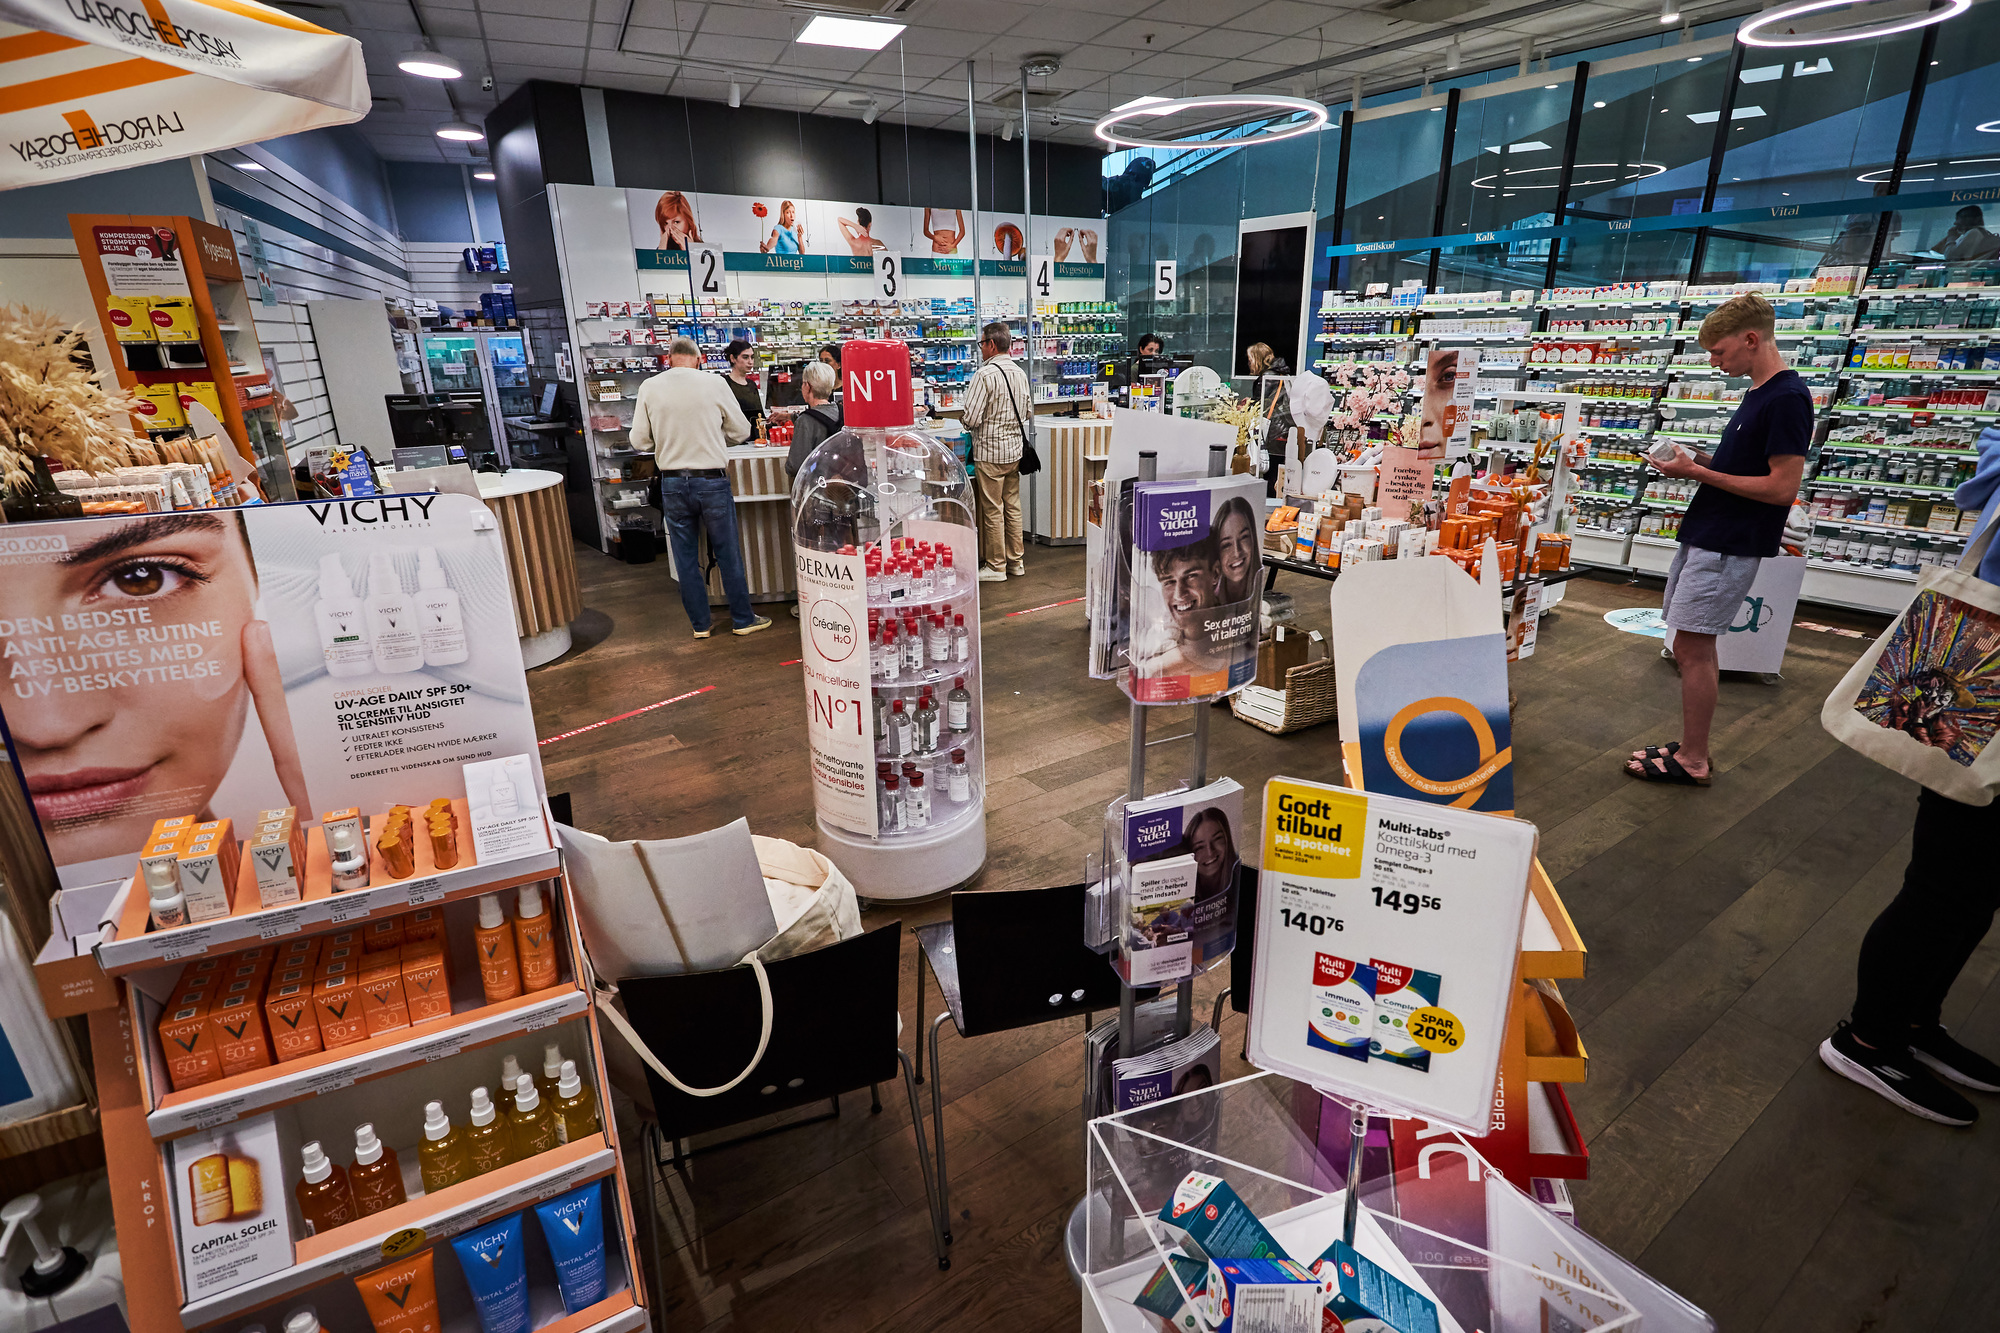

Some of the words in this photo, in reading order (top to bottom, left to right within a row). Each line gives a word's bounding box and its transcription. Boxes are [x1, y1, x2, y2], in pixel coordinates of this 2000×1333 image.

[1770, 205, 1800, 217] Vital
[1608, 220, 1632, 231] Vital
[1475, 232, 1495, 242] Kalk
[201, 236, 233, 266] Rygestop
[1355, 240, 1396, 253] Kosttilskud
[700, 250, 718, 292] 2
[765, 256, 804, 270] Allergi
[932, 261, 958, 272] Mave
[1059, 264, 1094, 276] Rygestop
[882, 256, 896, 297] 3
[1036, 260, 1050, 296] 4
[1158, 266, 1172, 295] 5
[1393, 466, 1422, 475] Forebyg
[1390, 480, 1413, 488] beskyt
[1402, 487, 1424, 495] solens
[305, 495, 436, 526] VICHY
[1160, 505, 1197, 521] Sund
[323, 522, 431, 534] LABORATOIRES
[1158, 517, 1199, 531] viden
[1172, 529, 1193, 537] apoteket
[328, 610, 354, 618] VICHY
[378, 606, 403, 614] VICHY
[0, 616, 55, 637] DEN
[60, 606, 153, 631] BEDSTE
[812, 616, 851, 633] Créaline
[1203, 619, 1221, 632] Sex
[1222, 618, 1231, 629] er
[1231, 611, 1253, 627] noget
[3, 629, 130, 659] ANTI-AGE
[135, 620, 223, 645] RUTINE
[1210, 631, 1219, 642] vi
[1220, 626, 1239, 640] taler
[1239, 624, 1252, 636] om
[9, 649, 144, 679] AFSLUTTES
[149, 642, 204, 664] MED
[13, 660, 222, 699] UV-BESKYTTELSE
[815, 671, 860, 690] micellaire
[333, 689, 366, 700] CAPITAL
[366, 685, 393, 695] SOLEIL
[334, 694, 386, 711] UV-AGE
[387, 689, 423, 703] DAILY
[426, 686, 447, 698] SPF
[450, 683, 472, 693] 50+
[639, 703, 659, 711] VIS
[659, 690, 700, 705] HENSYN
[337, 707, 396, 723] SOLCREME
[397, 705, 412, 714] TIL
[414, 696, 466, 712] ANSIGTET
[338, 723, 354, 732] TIL
[355, 715, 403, 729] SENSITIV
[406, 710, 431, 722] HUD
[351, 730, 390, 743] ULTRALET
[391, 721, 445, 736] KONSISTENS
[538, 737, 559, 745] VIS
[560, 720, 607, 739] HENSYN
[353, 740, 383, 752] FEDTER
[384, 737, 403, 747] IKKE
[355, 747, 405, 762] EFTERLADER
[406, 742, 436, 753] INGEN
[436, 738, 462, 749] HVIDE
[463, 732, 498, 744] MÆRKER
[350, 768, 388, 780] DEDIKERET
[400, 759, 442, 771] VIDENSKAB
[456, 753, 476, 762] SUND
[477, 750, 492, 758] HUD
[822, 753, 864, 771] nettoyante
[828, 774, 865, 791] sensibles
[1415, 763, 1498, 793] mælkesyrebakterier
[1278, 794, 1332, 820] Godt
[1138, 820, 1170, 836] Sund
[1276, 814, 1342, 843] tilbud
[1136, 829, 1171, 844] viden
[255, 846, 286, 857] VICHY
[1274, 832, 1291, 845] på
[1292, 836, 1351, 858] apoteket
[1376, 842, 1432, 863] Omega-3
[1377, 831, 1445, 854] Kosttilskud
[1447, 846, 1477, 860] med
[182, 858, 214, 869] VICHY
[1373, 857, 1402, 869] Complet
[1402, 863, 1433, 876] Omega-3
[1373, 863, 1383, 871] 90
[1383, 866, 1396, 874] stk.
[1140, 879, 1161, 888] Spiller
[1161, 878, 1170, 886] du
[1170, 874, 1185, 884] også
[1140, 885, 1154, 894] med
[1164, 881, 1188, 890] helbred
[1140, 892, 1154, 901] som
[1154, 889, 1181, 899] indsats?
[1309, 886, 1336, 898] Tabletter
[1318, 955, 1346, 970] Multi
[1374, 962, 1402, 978] Multi
[406, 968, 441, 982] VICHY
[363, 979, 398, 994] VICHY
[319, 990, 354, 1005] VICHY
[1324, 990, 1361, 1006] Immuno
[271, 998, 308, 1014] VICHY
[215, 1010, 252, 1025] VICHY
[1420, 1013, 1454, 1030] SPAR
[165, 1022, 204, 1038] VICHY
[328, 1025, 347, 1040] 30
[1412, 1022, 1458, 1047] 20%
[281, 1035, 300, 1050] 30
[1128, 1091, 1162, 1103] viden
[1129, 1083, 1160, 1095] Sund
[476, 1160, 492, 1171] 30
[431, 1174, 448, 1186] 30
[365, 1199, 383, 1212] 30
[553, 1197, 589, 1218] VICHY
[191, 1232, 239, 1254] CAPITAL
[240, 1219, 278, 1237] SOLEIL
[404, 1230, 418, 1239] 2
[471, 1230, 509, 1253] VICHY
[375, 1269, 417, 1291] VICHY
